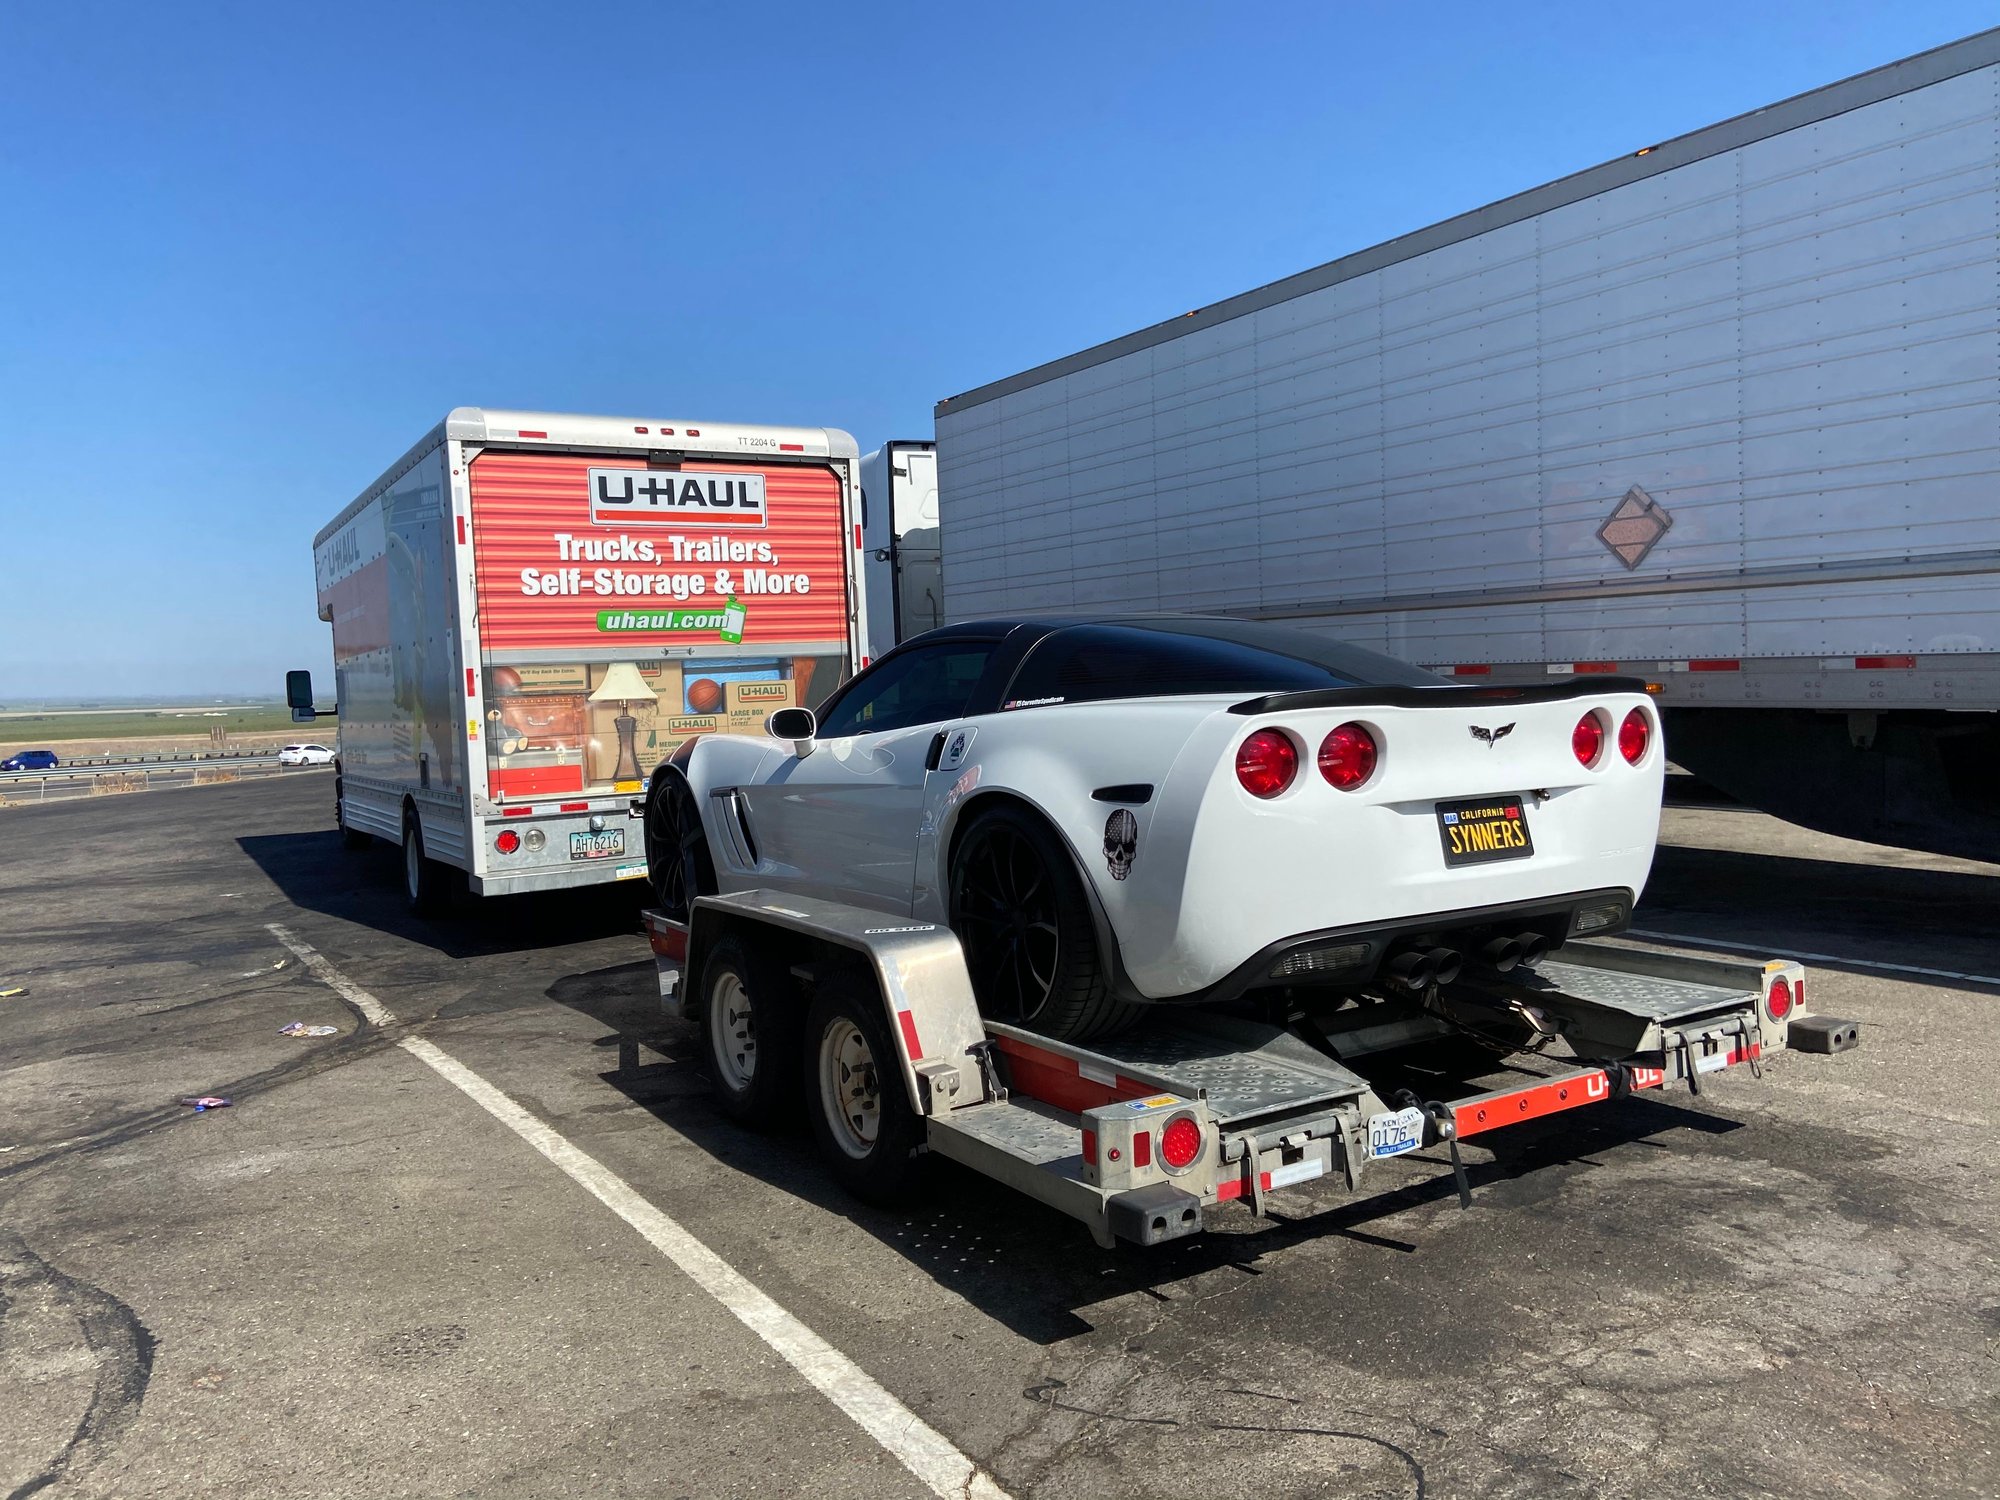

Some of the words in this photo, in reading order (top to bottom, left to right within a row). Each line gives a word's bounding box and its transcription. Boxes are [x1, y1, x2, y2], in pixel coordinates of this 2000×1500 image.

[738, 437, 748, 446] TT
[750, 438, 768, 447] 2204
[770, 438, 776, 447] G
[598, 476, 759, 508] U-HAUL
[327, 527, 361, 577] U-HAUL
[554, 533, 662, 566] Trucks,
[668, 535, 778, 567] Trailers,
[520, 567, 705, 601] Self-Storage
[714, 568, 736, 595] &
[743, 569, 810, 595] More
[606, 611, 730, 630] uhaul.com
[741, 686, 785, 697] U-HAUL
[730, 709, 750, 717] LARGE
[672, 719, 714, 729] U-HAUL
[1460, 807, 1505, 820] CALIFORNIA
[575, 834, 620, 853] AH76216
[1448, 820, 1526, 854] SYNNERS
[1587, 1066, 1660, 1098] U-UL
[1372, 1125, 1408, 1148] 0176
